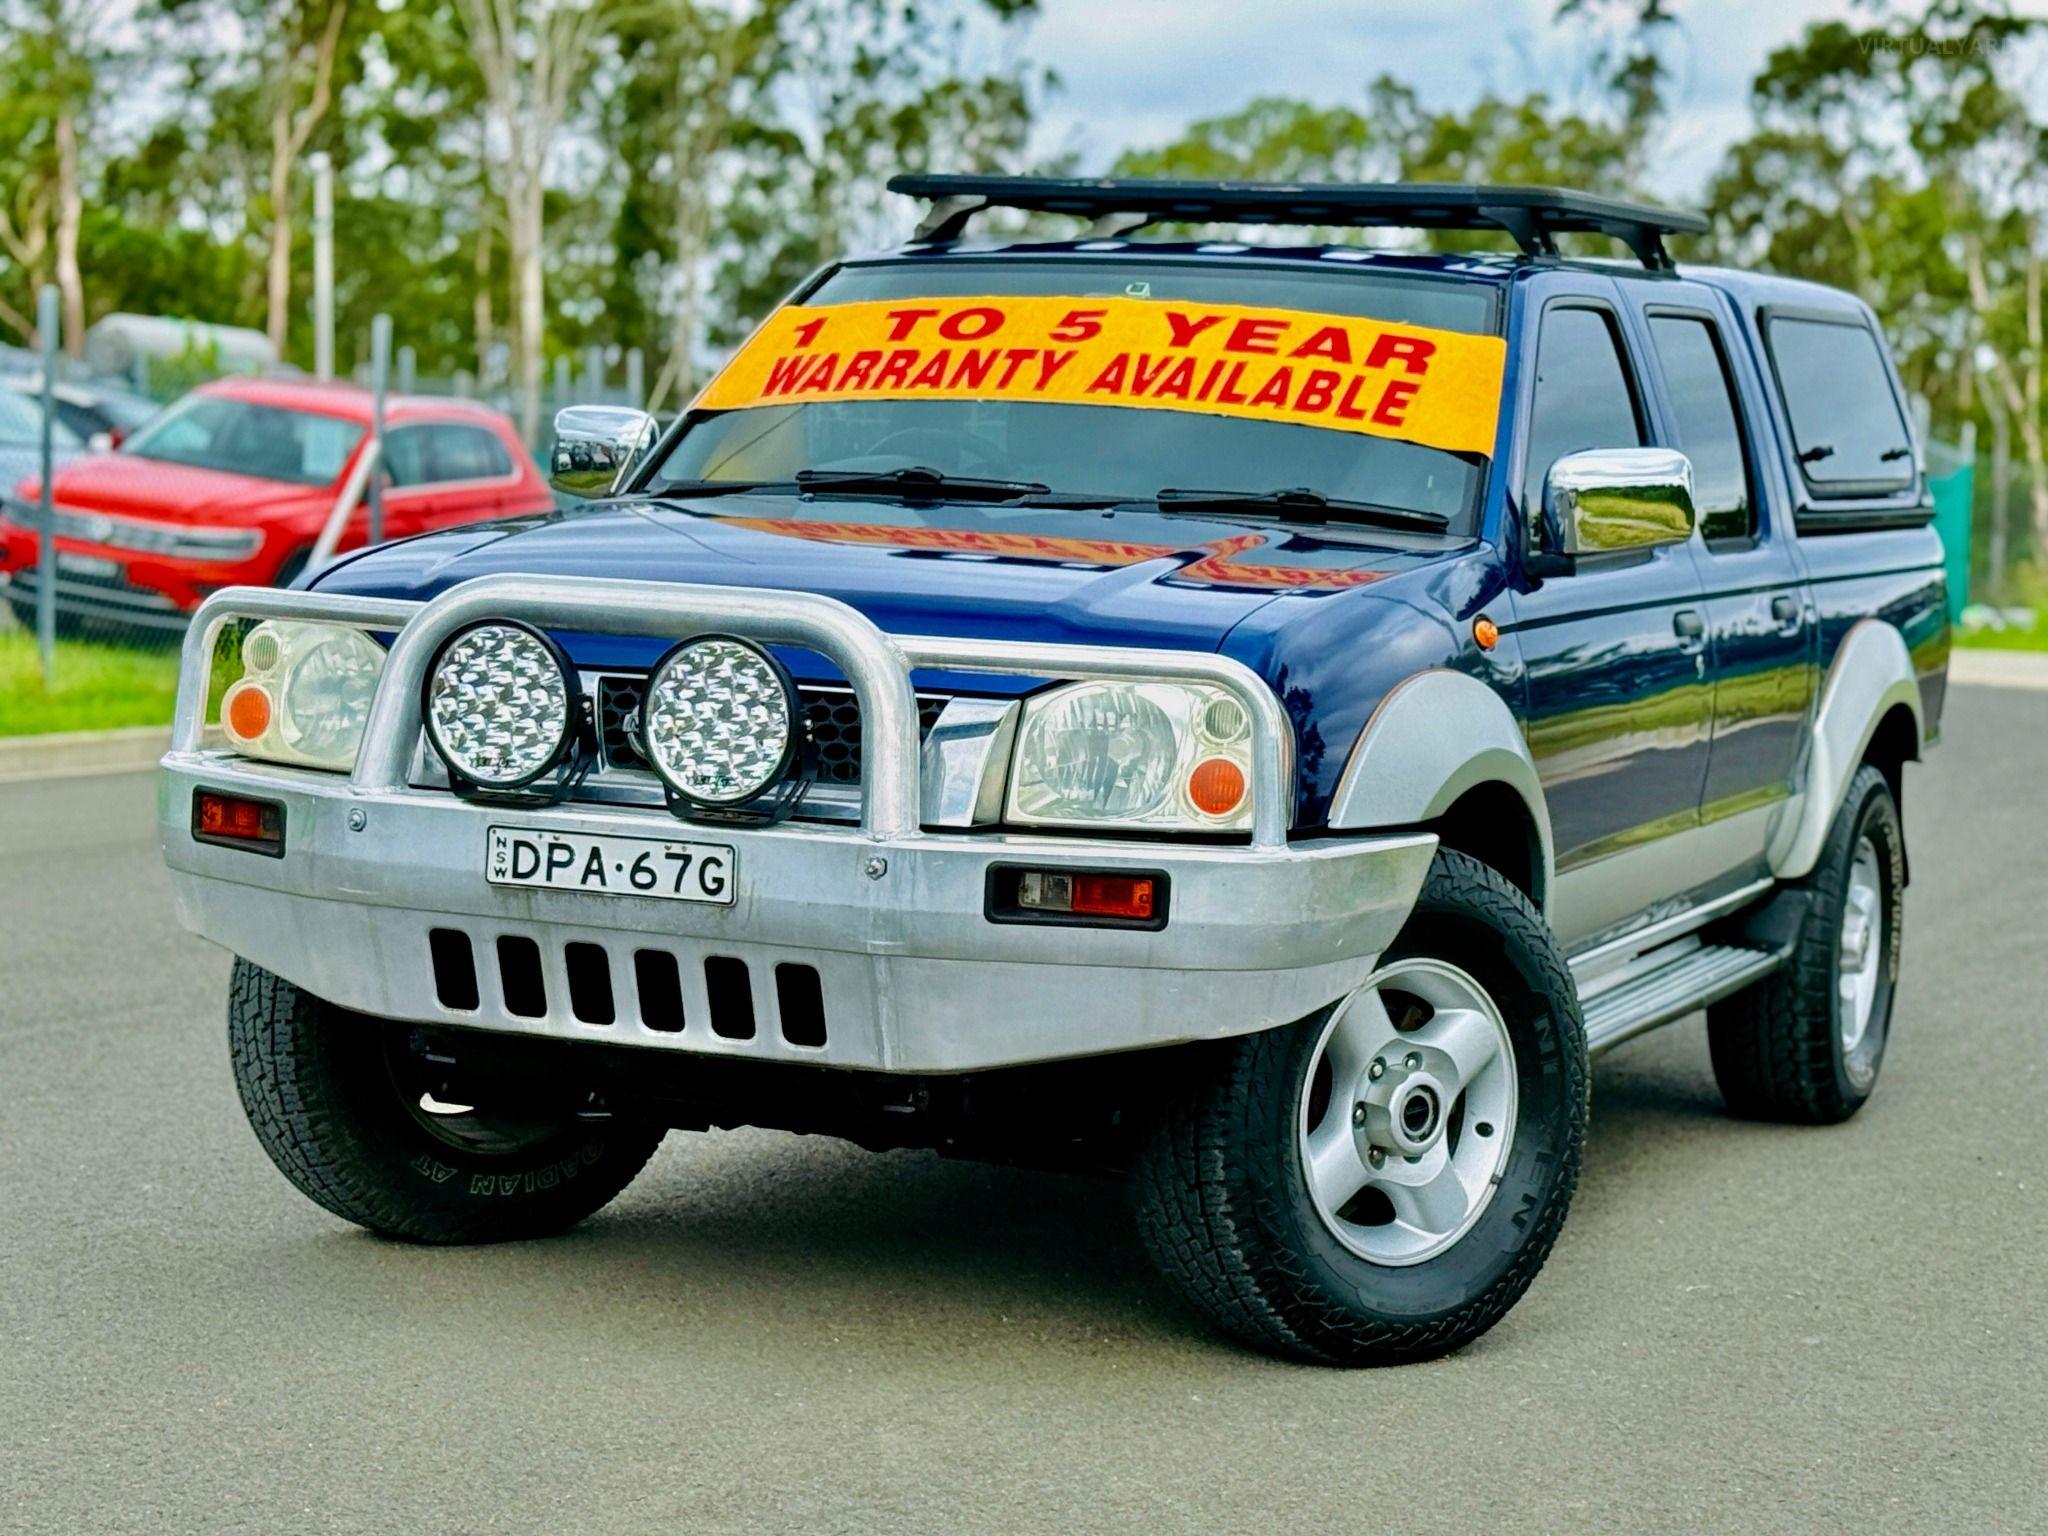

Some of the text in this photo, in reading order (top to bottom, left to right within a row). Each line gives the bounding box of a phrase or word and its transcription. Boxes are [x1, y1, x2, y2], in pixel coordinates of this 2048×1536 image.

[794, 307, 1437, 376] 1 TO 5 YEAR
[761, 348, 1421, 428] WARRANTY AVAILABLE
[493, 835, 508, 879] NSW
